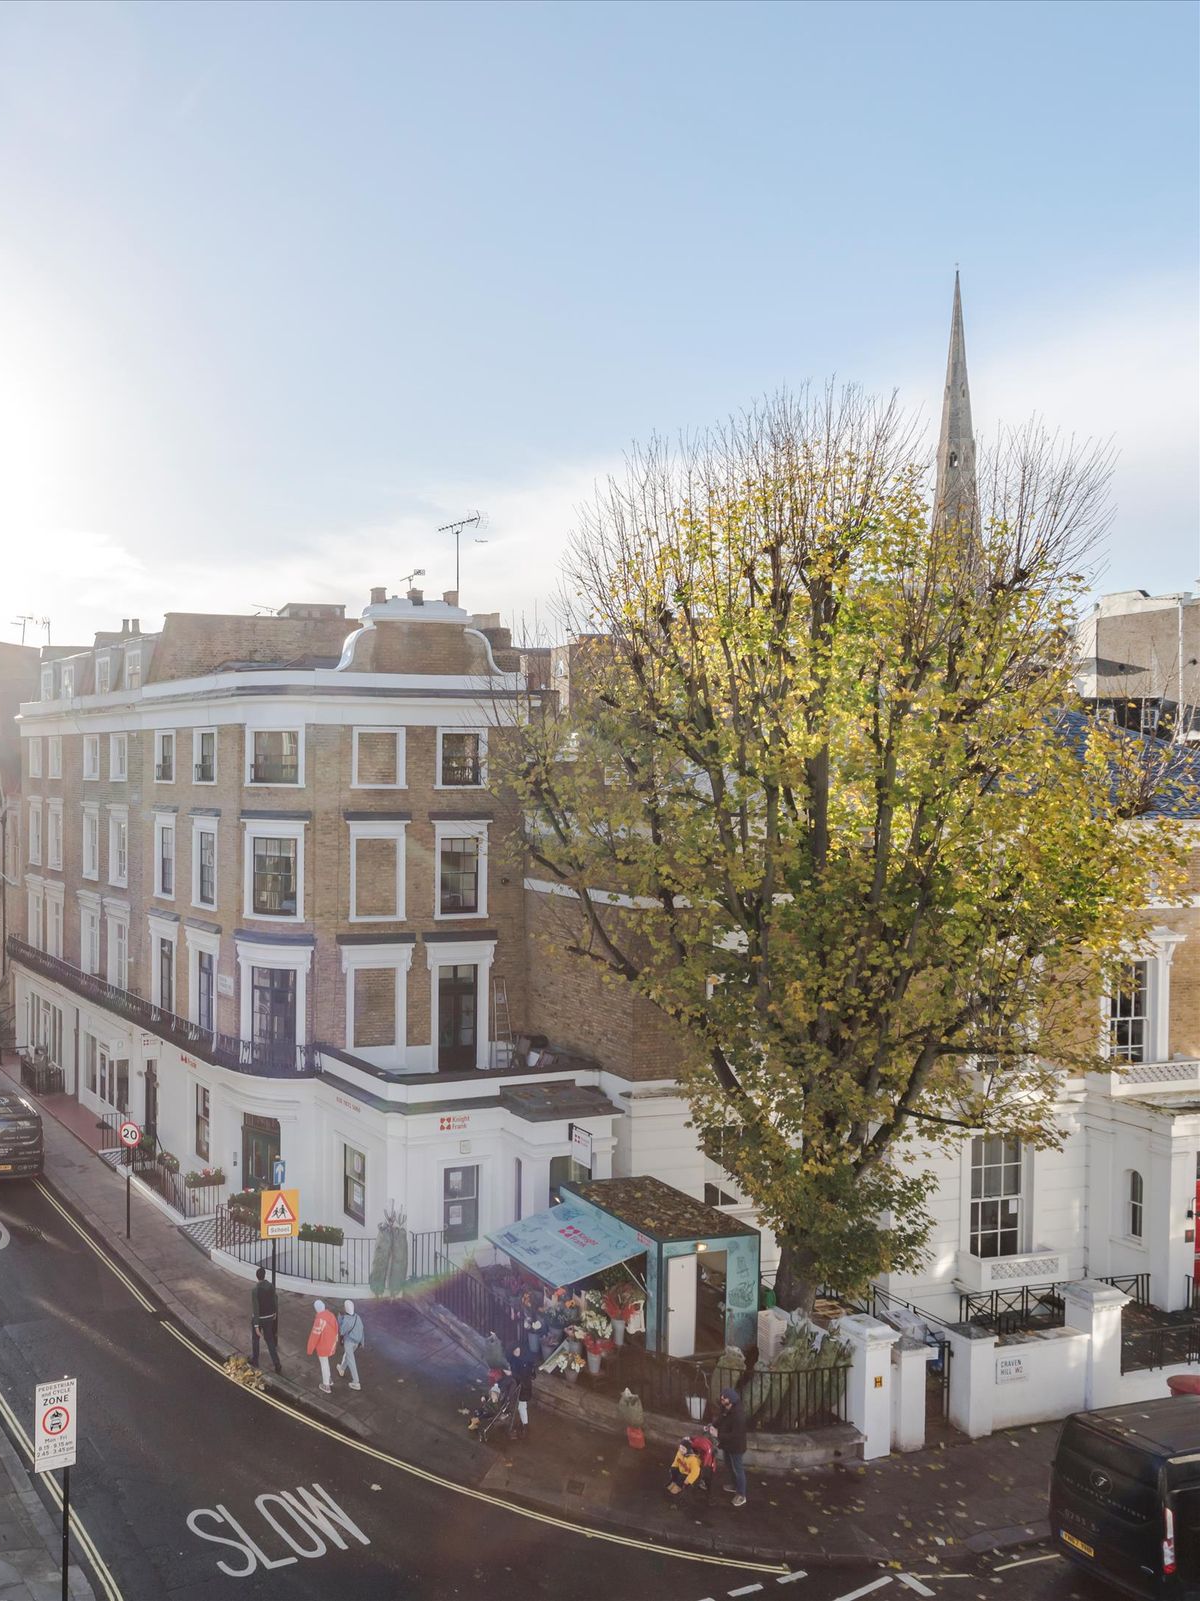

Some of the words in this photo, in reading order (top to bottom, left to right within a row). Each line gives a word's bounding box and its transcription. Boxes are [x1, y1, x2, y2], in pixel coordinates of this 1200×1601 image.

[123, 1128, 137, 1140] 20
[38, 1381, 75, 1392] PEDESTRIAN
[52, 1388, 71, 1396] CYCLE
[43, 1394, 69, 1406] ZONE
[186, 1483, 371, 1577] SLOW
